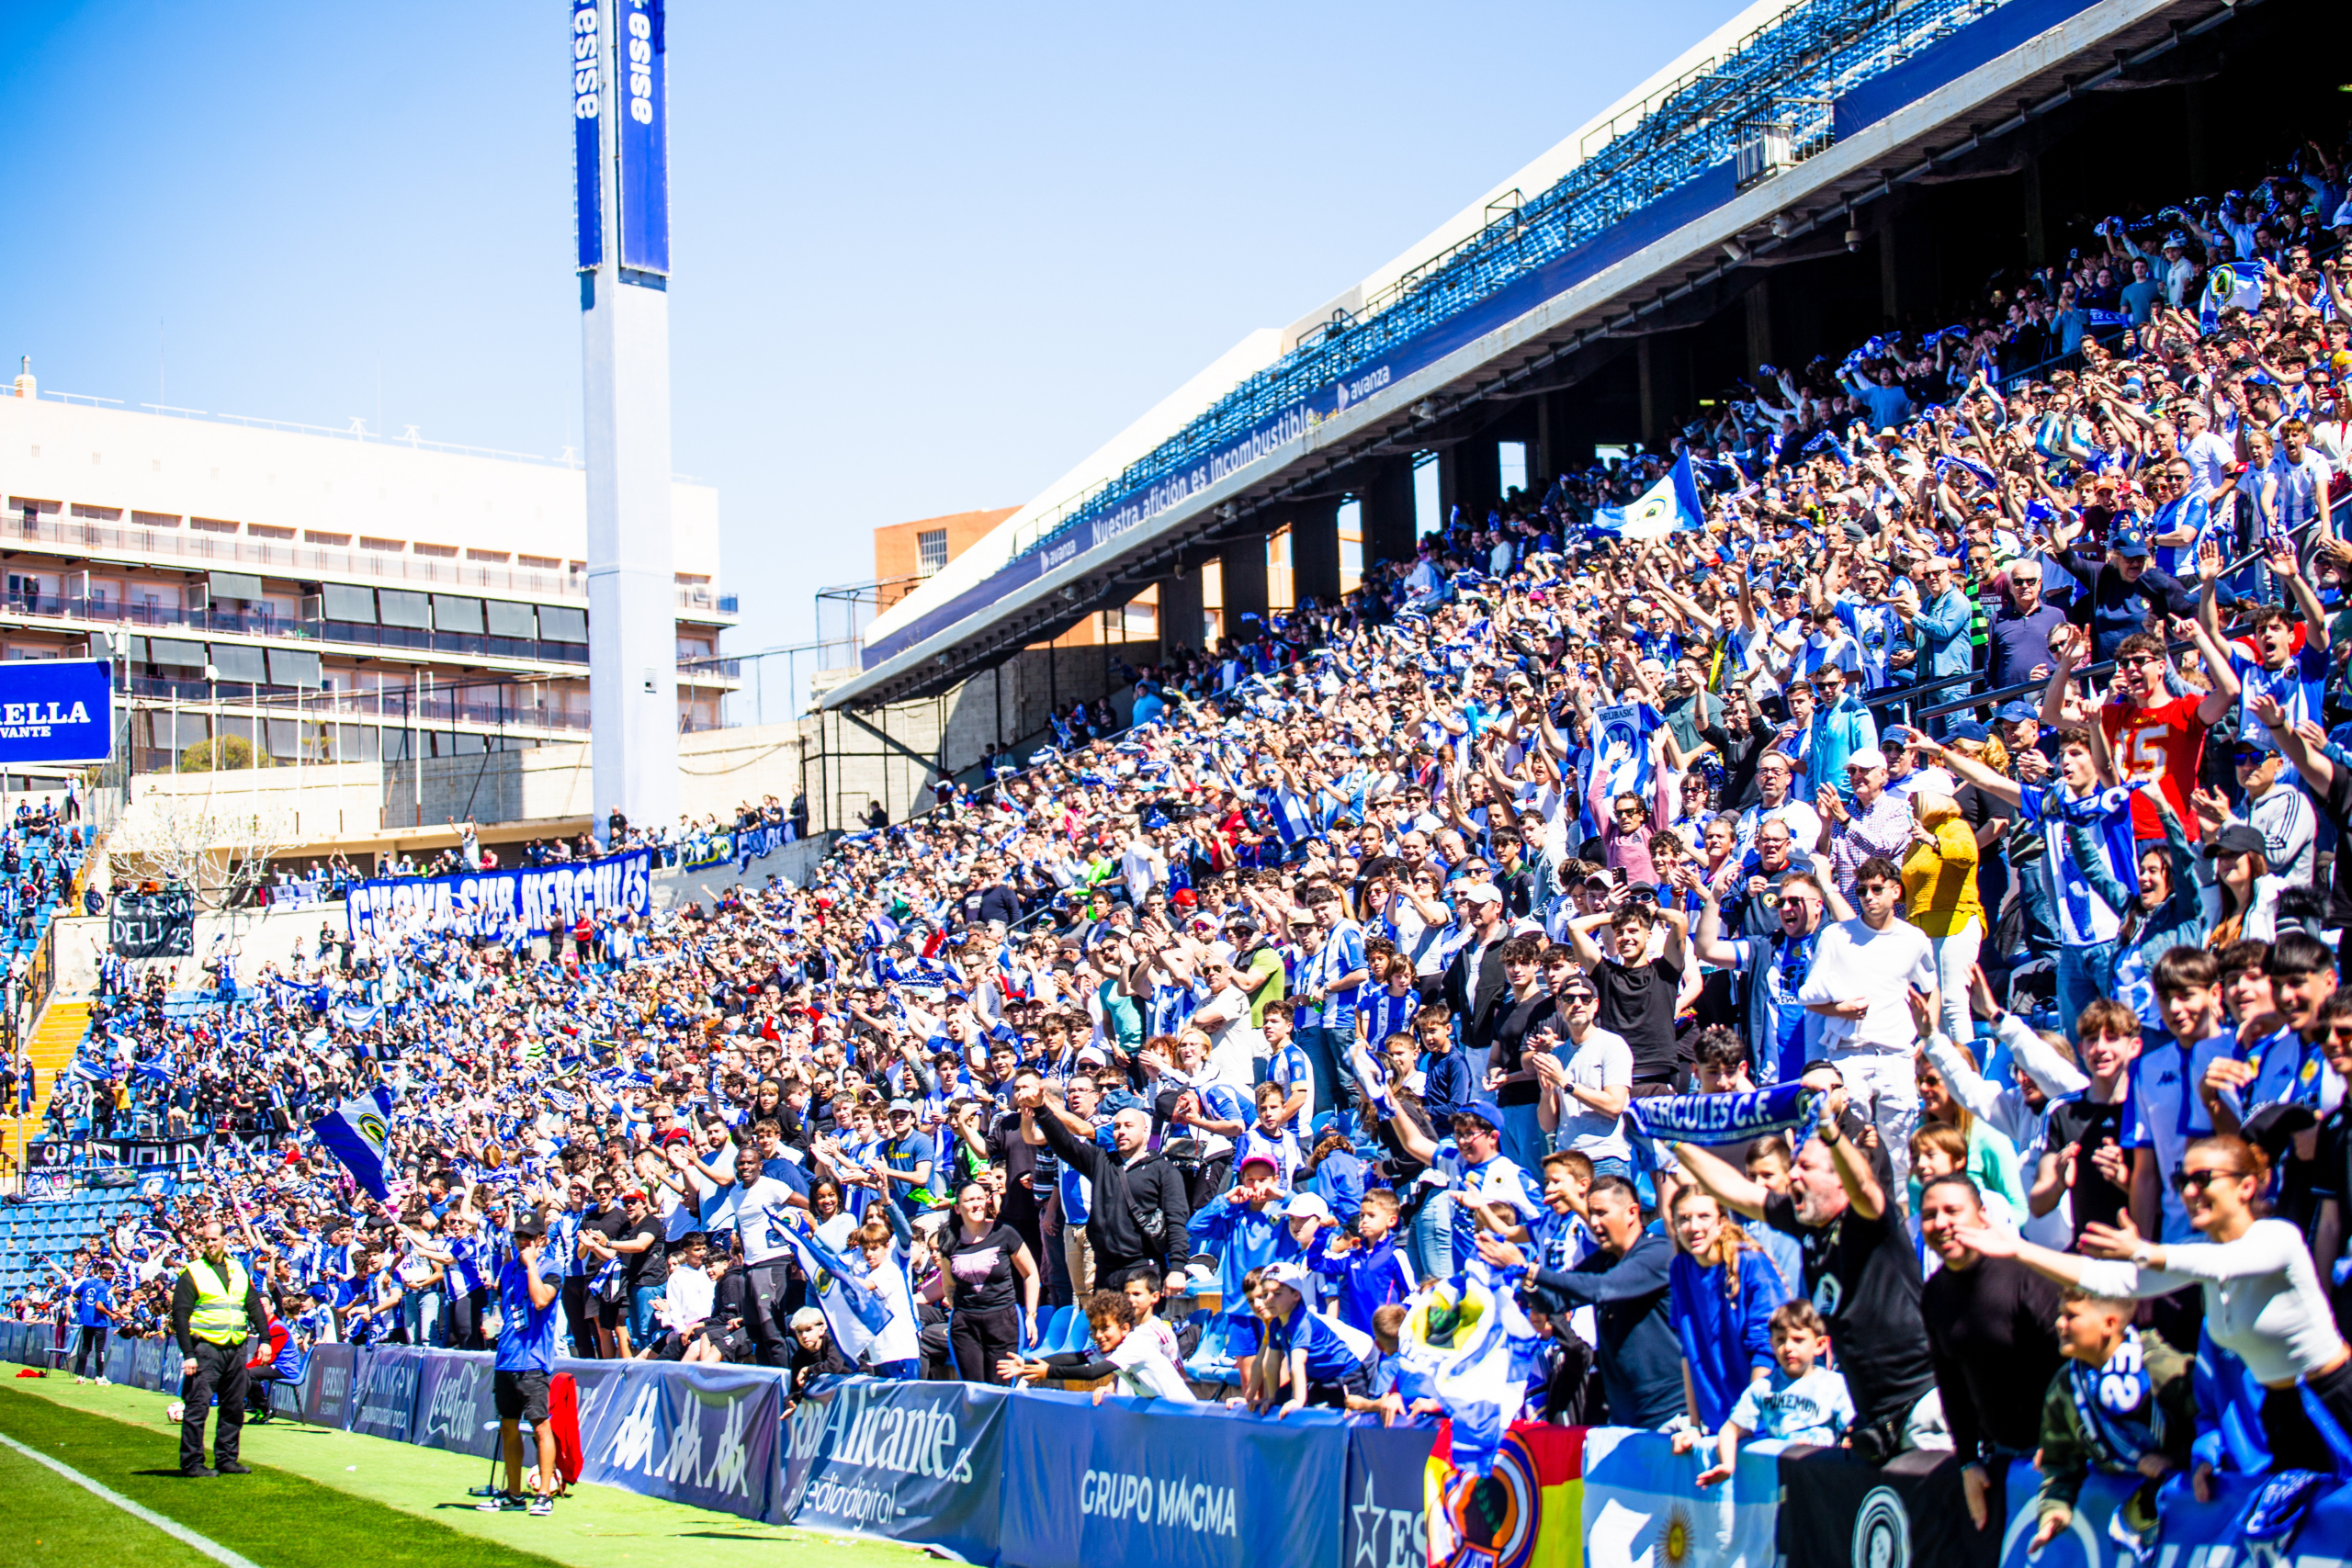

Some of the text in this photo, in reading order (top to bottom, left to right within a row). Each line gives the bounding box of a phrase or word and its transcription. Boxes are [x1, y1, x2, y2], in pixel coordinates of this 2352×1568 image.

[574, 8, 599, 119] asisa
[628, 12, 653, 125] asisa
[1351, 365, 1390, 400] avanza
[1091, 404, 1315, 545] Nuestra afición es incombustible
[1049, 538, 1076, 567] avanza
[0, 701, 91, 726] ELLA
[1599, 707, 1634, 722] DELIBASIC
[459, 876, 516, 937] SUR
[521, 854, 649, 931] HERCULES
[169, 927, 193, 951] 23
[1636, 1090, 1774, 1131] HERCULES C.F.
[842, 1476, 897, 1532] digital
[1080, 1470, 1238, 1538] GRUPO MAGMA
